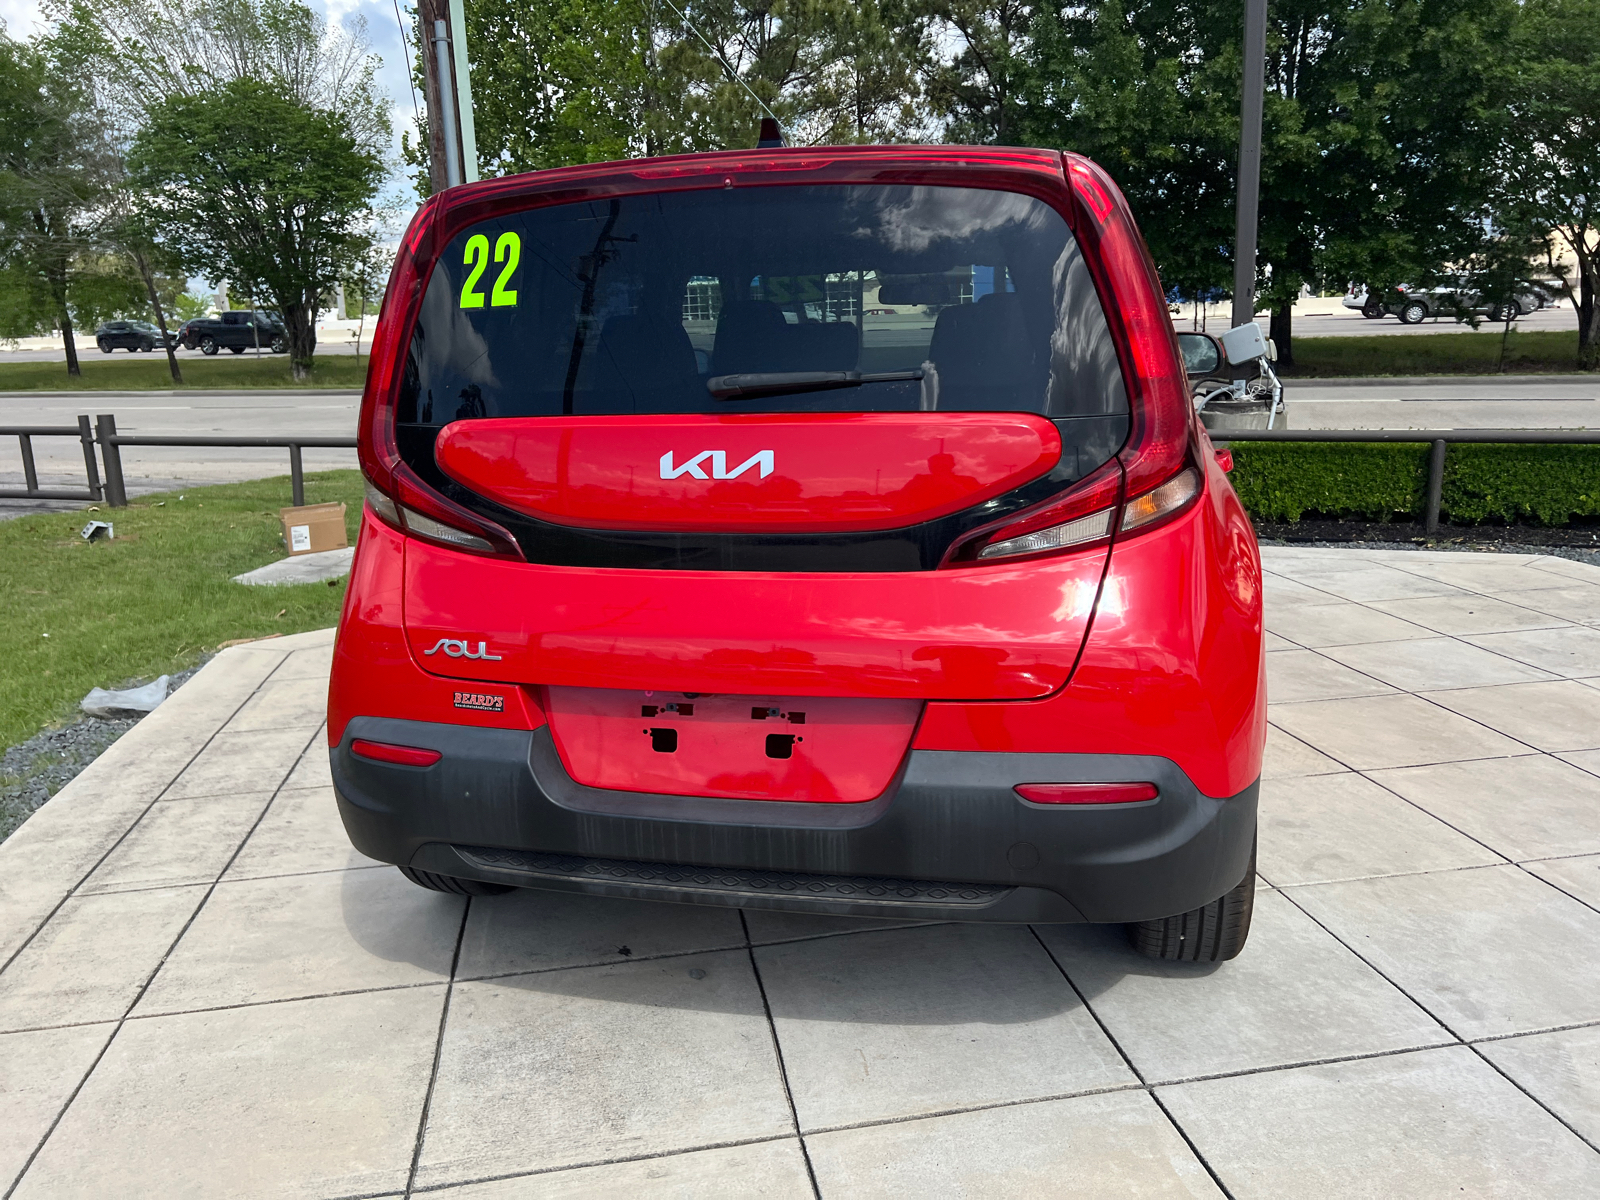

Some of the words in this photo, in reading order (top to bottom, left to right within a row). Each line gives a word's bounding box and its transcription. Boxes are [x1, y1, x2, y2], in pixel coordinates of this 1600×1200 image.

[460, 231, 521, 309] 22
[660, 450, 774, 479] KIA
[424, 639, 502, 660] SOUL
[454, 693, 503, 707] BEARD'S
